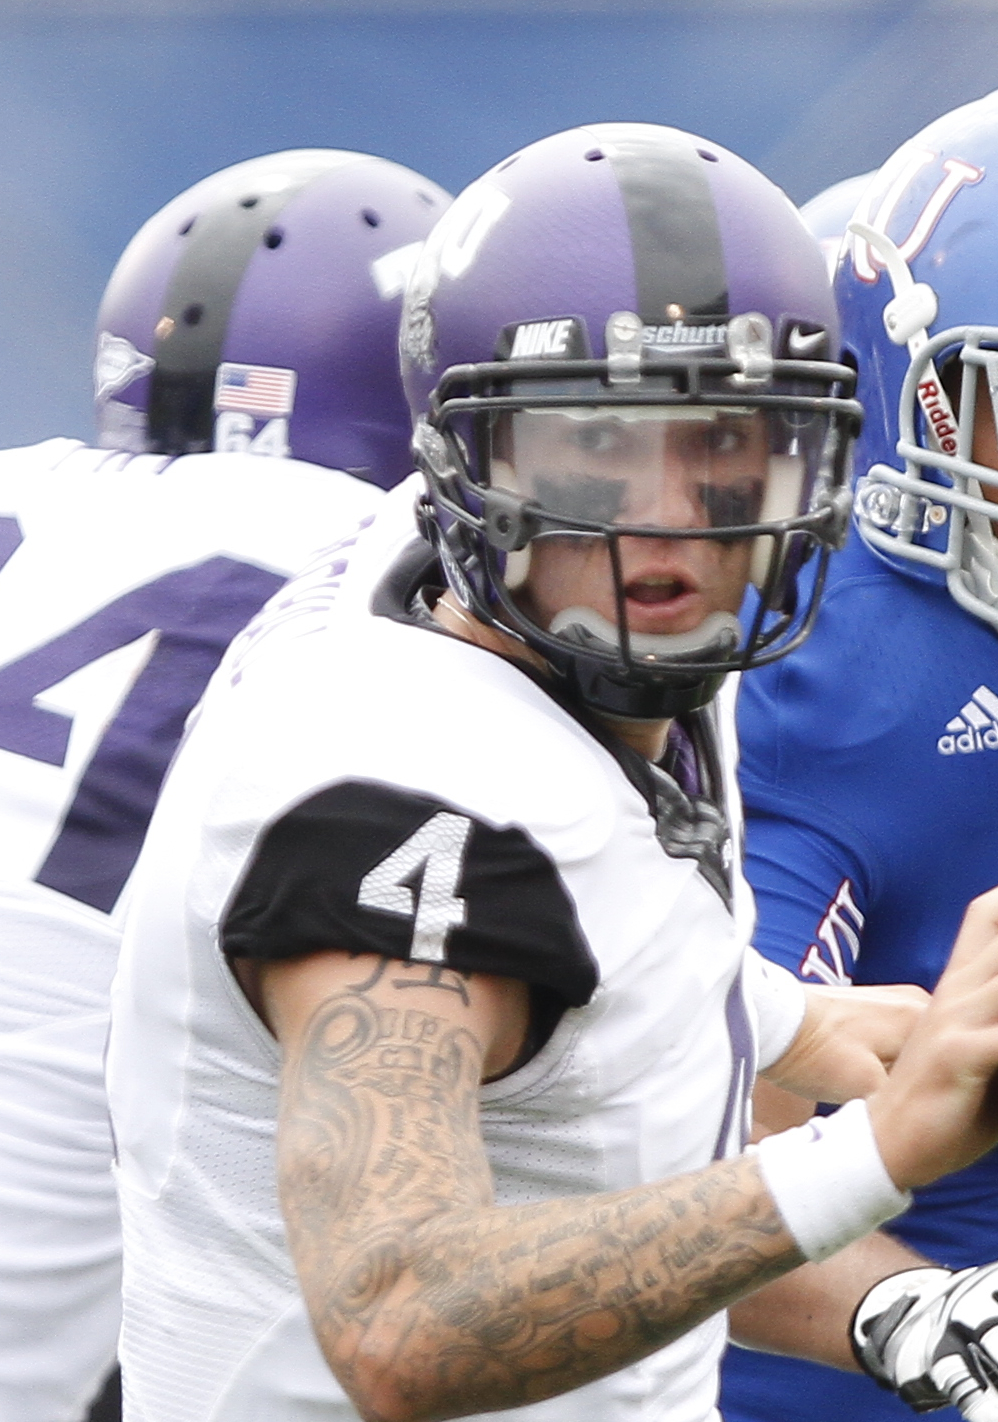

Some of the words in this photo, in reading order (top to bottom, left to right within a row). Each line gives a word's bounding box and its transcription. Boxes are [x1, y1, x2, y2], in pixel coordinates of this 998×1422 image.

[510, 317, 574, 359] NIKE
[214, 410, 293, 457] 64
[917, 378, 958, 457] Ridde
[356, 810, 472, 962] 4
